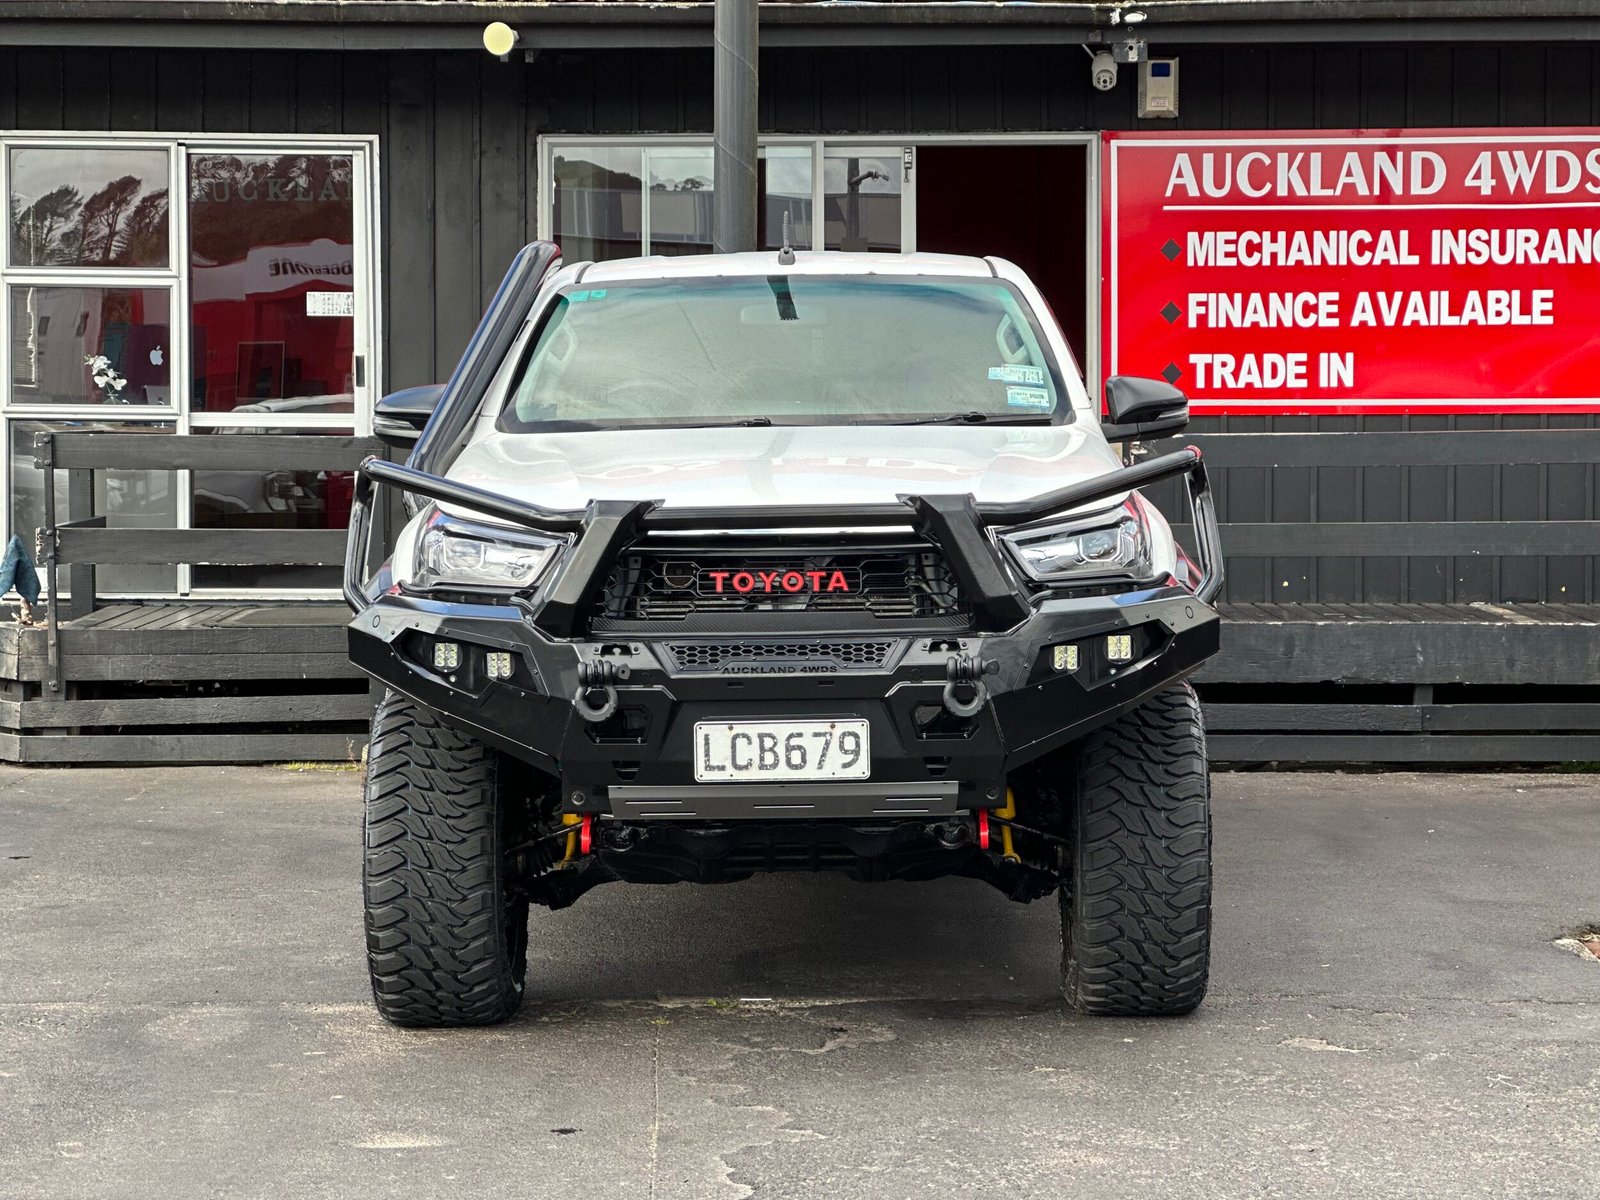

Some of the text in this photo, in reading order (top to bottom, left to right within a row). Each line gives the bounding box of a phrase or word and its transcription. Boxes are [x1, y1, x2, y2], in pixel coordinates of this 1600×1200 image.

[191, 176, 353, 202] AUCKLA
[1165, 151, 1447, 197] AUCKLAND
[1187, 228, 1600, 267] MECHANICAL INSURAN
[1187, 289, 1554, 328] FINANCE AVAILABLE
[1189, 352, 1354, 389] TRADE IN
[708, 570, 850, 594] TOYOTA
[722, 665, 837, 674] AUCKLAND 4WDS
[703, 730, 862, 772] LCB679
